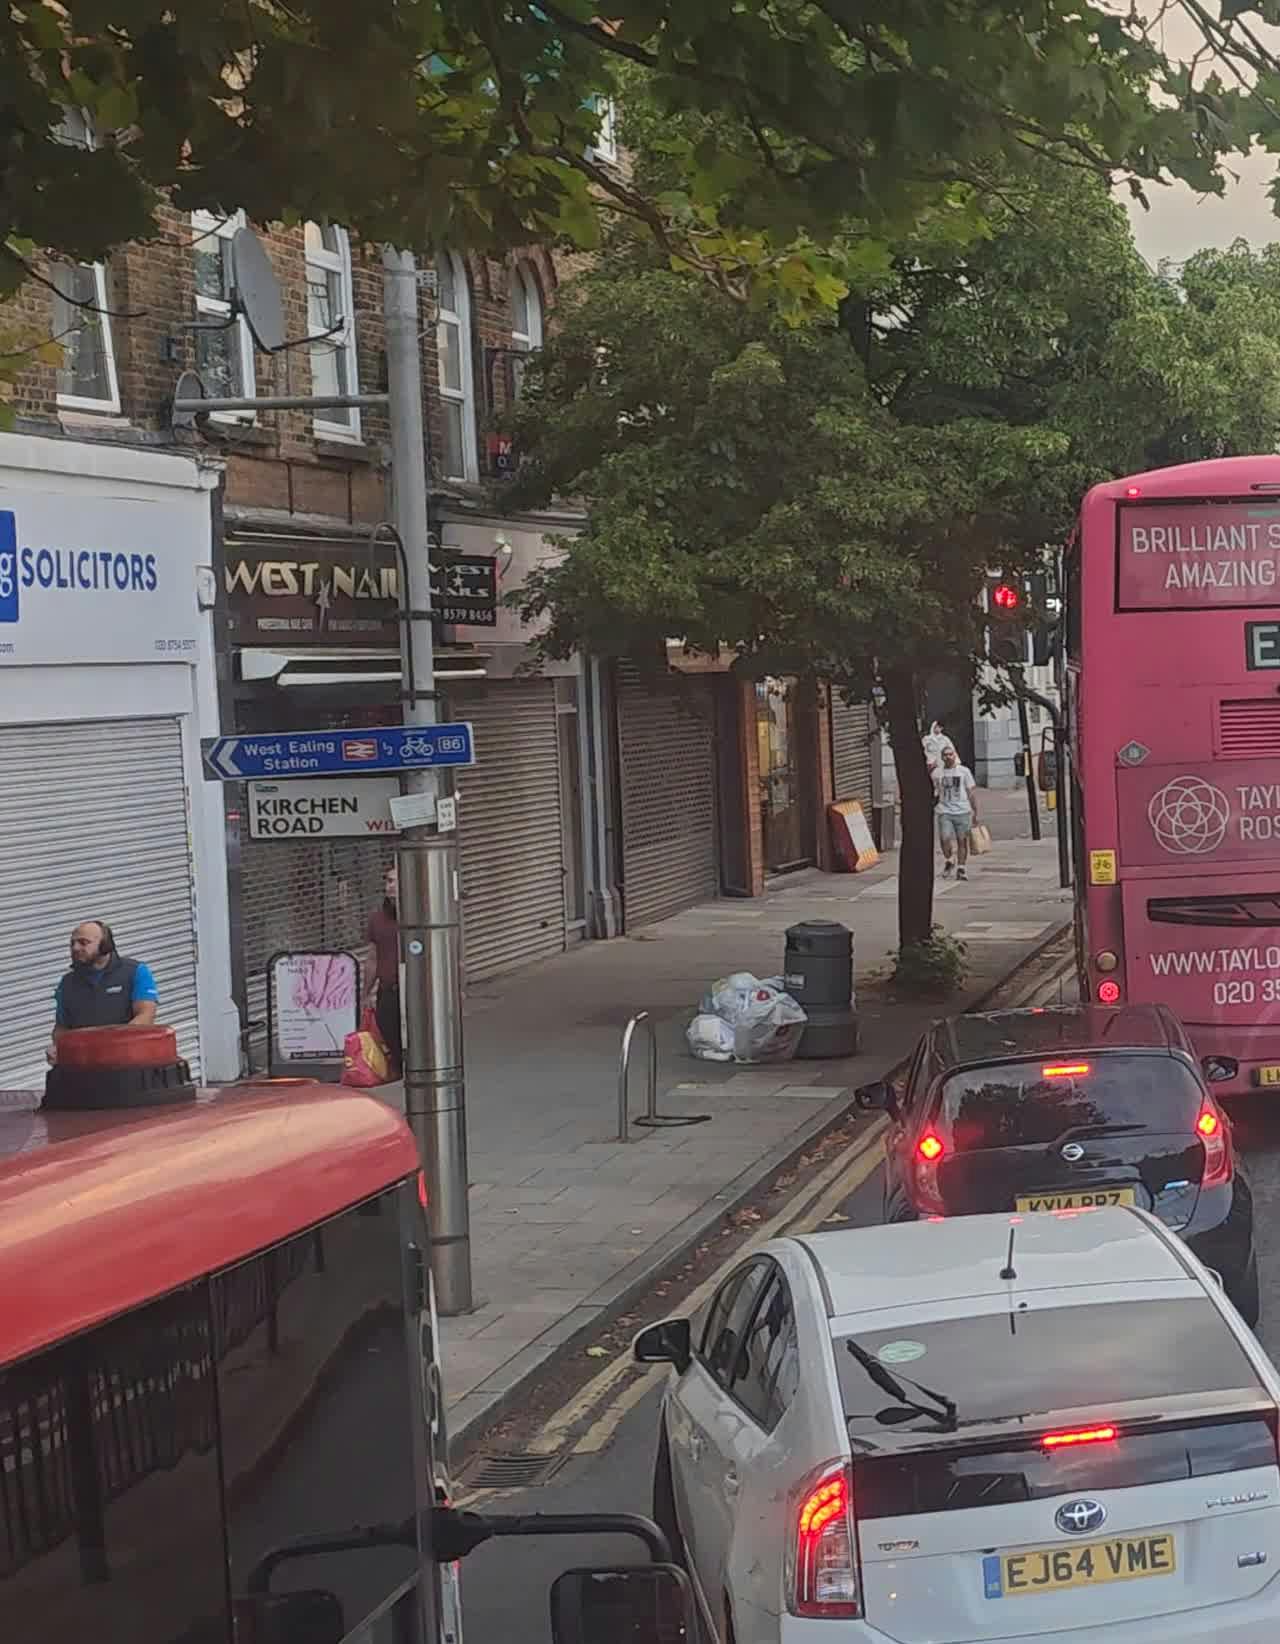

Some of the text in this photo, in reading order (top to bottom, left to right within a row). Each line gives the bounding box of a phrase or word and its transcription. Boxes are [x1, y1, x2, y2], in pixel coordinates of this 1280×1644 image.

[1131, 525, 1261, 553] BRILLIANT
[21, 547, 158, 591] SOLICITORS
[224, 560, 320, 597] WEST
[1164, 559, 1276, 589] AMAZING
[244, 743, 282, 756] West
[289, 740, 336, 754] Ealing
[263, 756, 319, 771] Station
[256, 797, 359, 815] KIRCHEN
[257, 817, 325, 835] ROAD
[1213, 982, 1254, 1005] 020
[877, 1539, 921, 1552] TOYOTA
[1007, 1538, 1170, 1588] EJ64 VME
